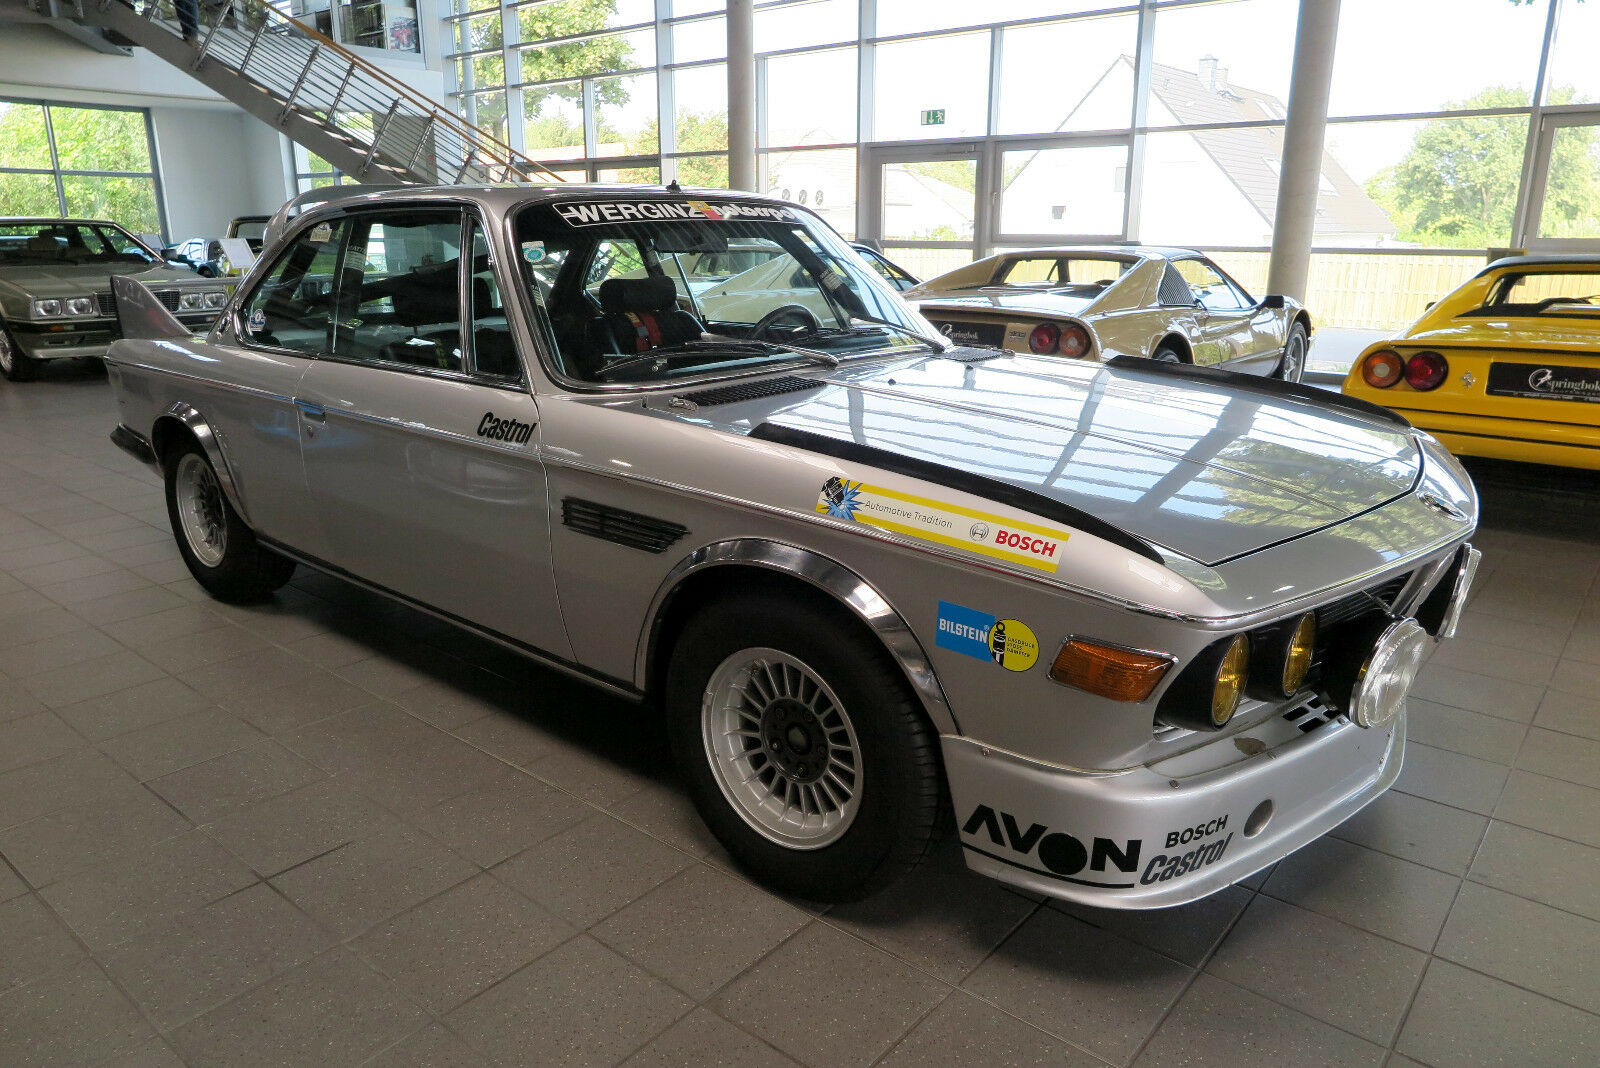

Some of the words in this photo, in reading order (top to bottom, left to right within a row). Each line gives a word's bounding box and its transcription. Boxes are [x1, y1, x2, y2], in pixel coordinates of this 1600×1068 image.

[570, 203, 707, 223] WERGINZ
[477, 411, 538, 446] Castrol
[865, 500, 912, 519] Automotive
[914, 511, 953, 529] Tradition
[995, 530, 1057, 557] BOSCH
[939, 618, 988, 644] BILSTEIN
[961, 803, 1142, 876] AVON
[1165, 814, 1229, 848] BOSCH
[1139, 832, 1234, 886] Castrol
